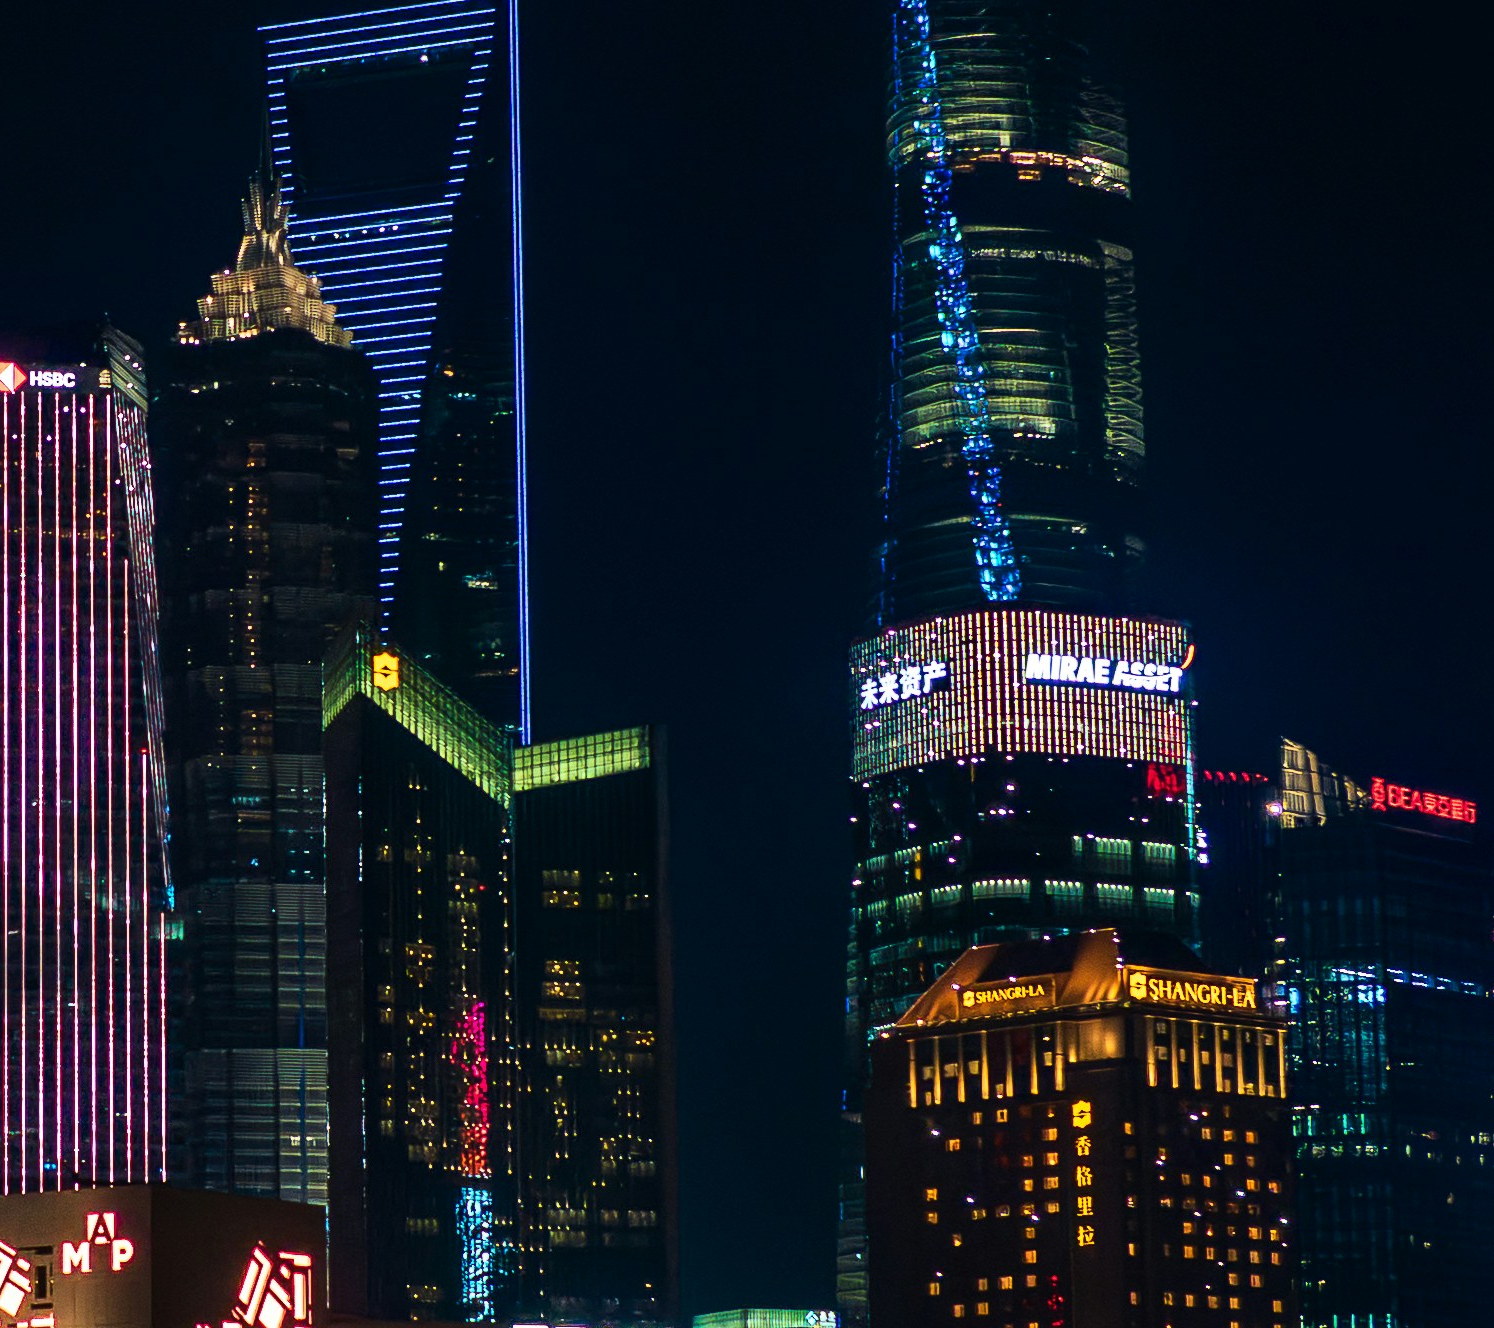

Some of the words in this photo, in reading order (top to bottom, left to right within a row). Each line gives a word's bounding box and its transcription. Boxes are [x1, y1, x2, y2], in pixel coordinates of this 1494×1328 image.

[29, 370, 76, 388] HSBC
[861, 660, 946, 709] 未来资产
[1025, 653, 1111, 684] MIRAE
[1112, 660, 1183, 692] ASSET
[975, 984, 1045, 1004] SHANGRI-LA
[1149, 979, 1257, 1009] SHANGRI-LA
[61, 1212, 135, 1275] MAP
